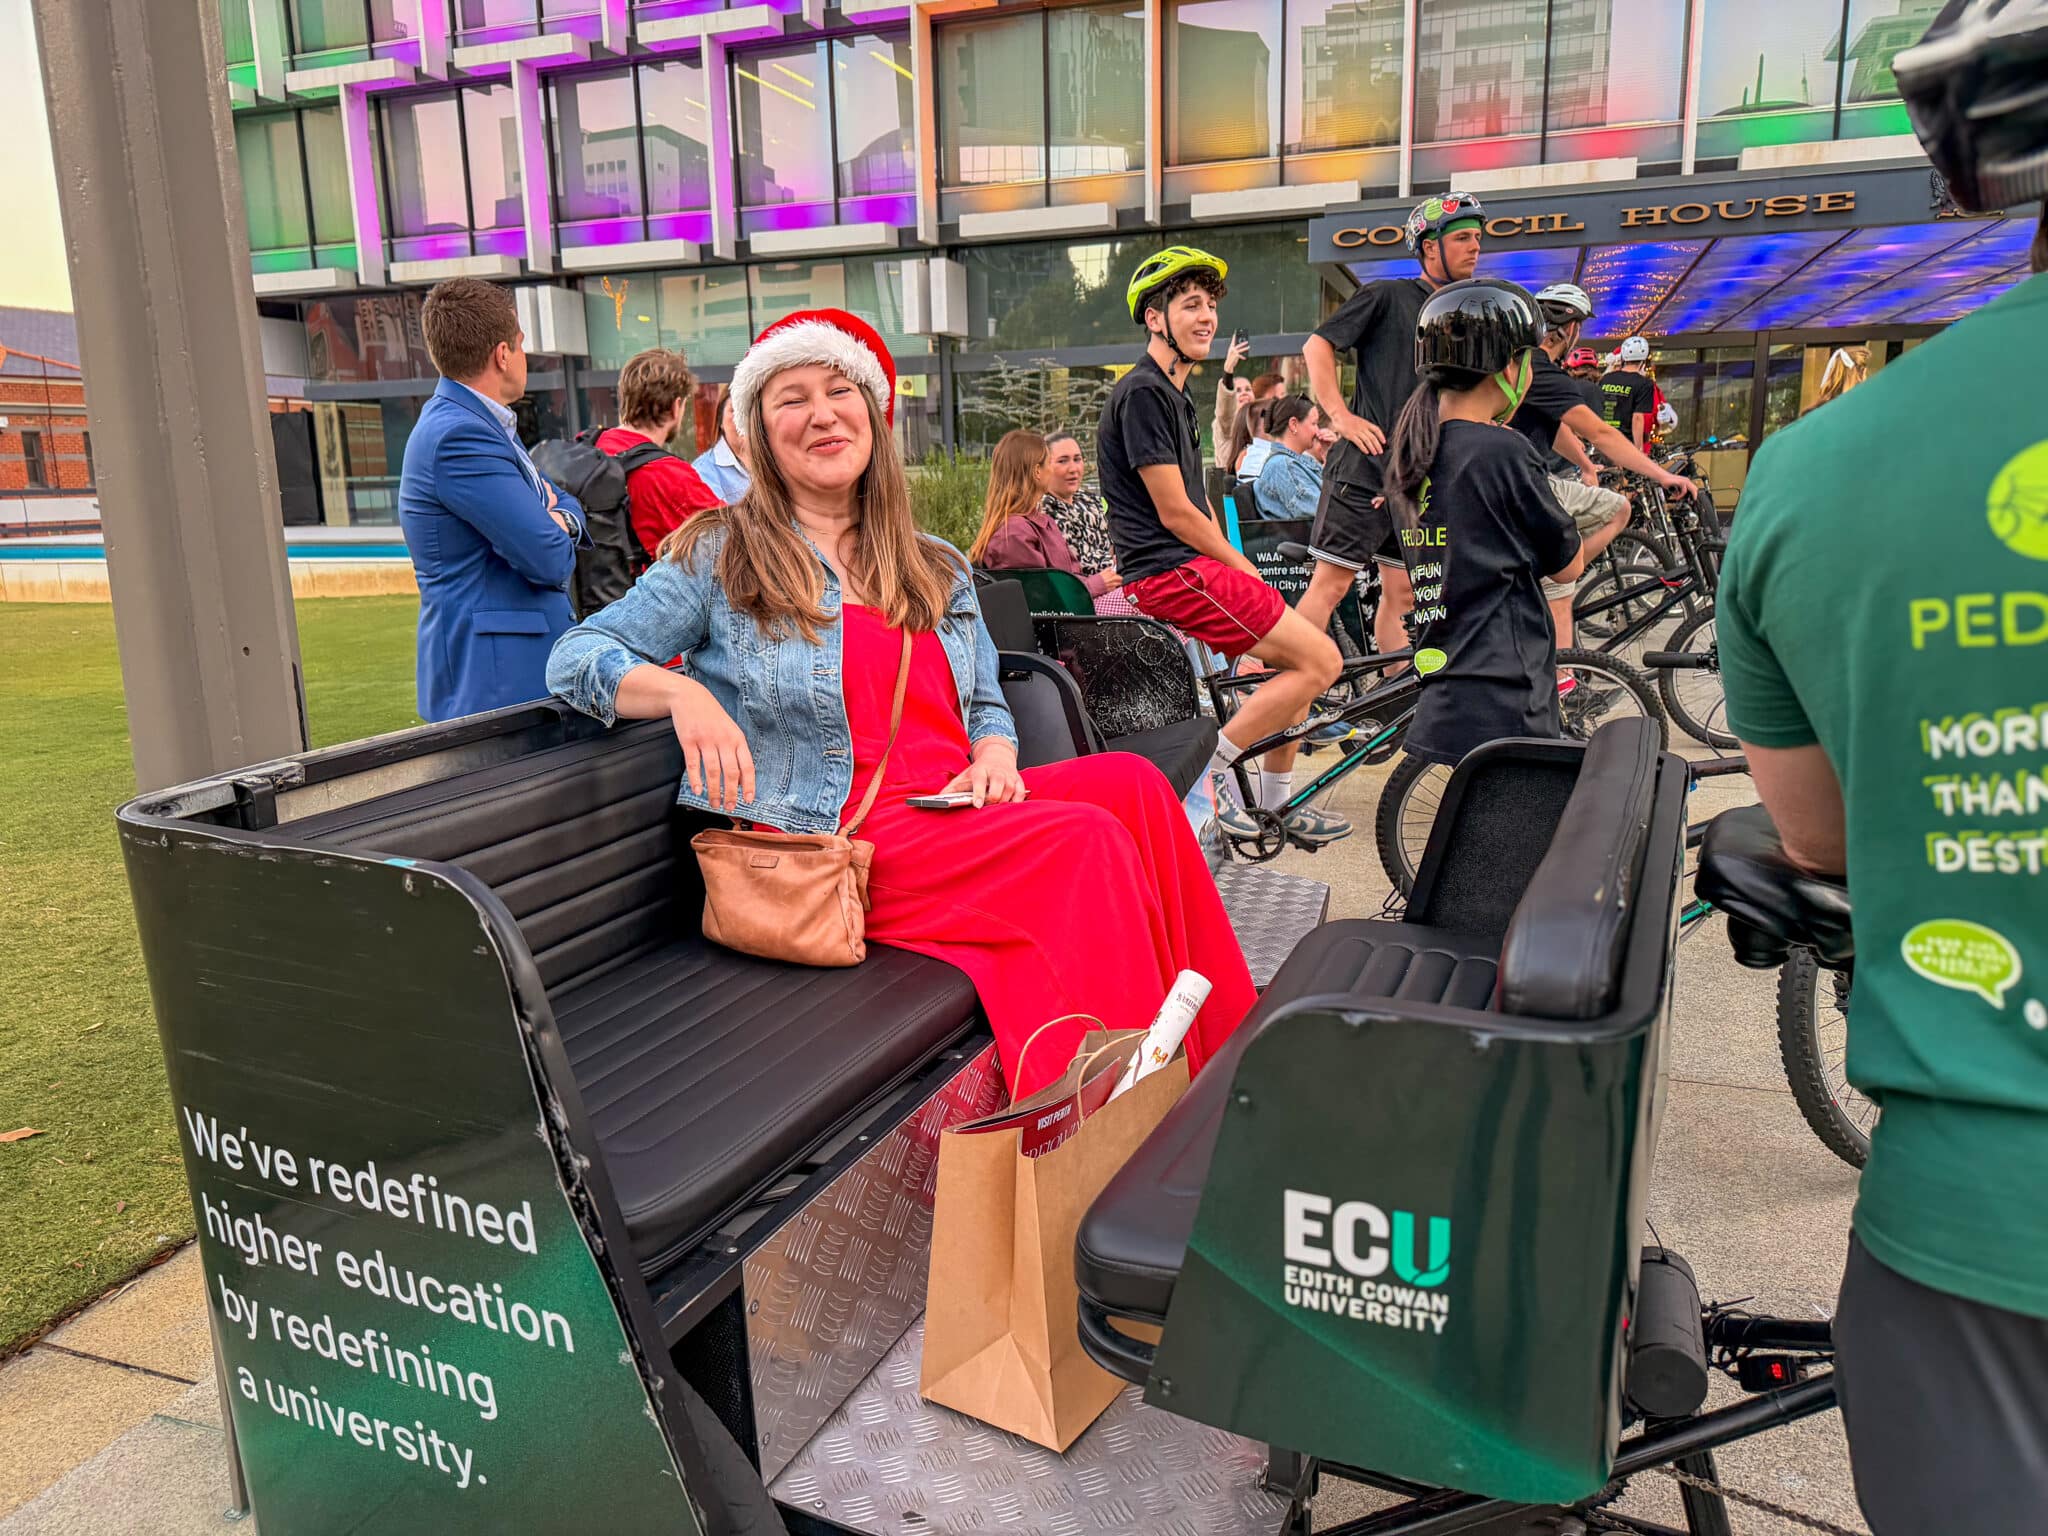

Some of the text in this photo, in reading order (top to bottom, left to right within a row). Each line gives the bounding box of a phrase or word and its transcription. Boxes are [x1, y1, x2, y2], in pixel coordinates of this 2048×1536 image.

[1332, 190, 1856, 248] COCIL HOUSE
[1258, 567, 1288, 576] centre
[1279, 580, 1298, 592] City
[183, 1106, 538, 1256] We've redefined
[202, 1192, 575, 1353] higher education
[1284, 1188, 1452, 1287] ECU
[1284, 1264, 1449, 1314] EDITH COWAN
[1284, 1284, 1448, 1335] UNIVERSITY
[218, 1274, 498, 1420] by redefining
[237, 1365, 488, 1489] a university.
